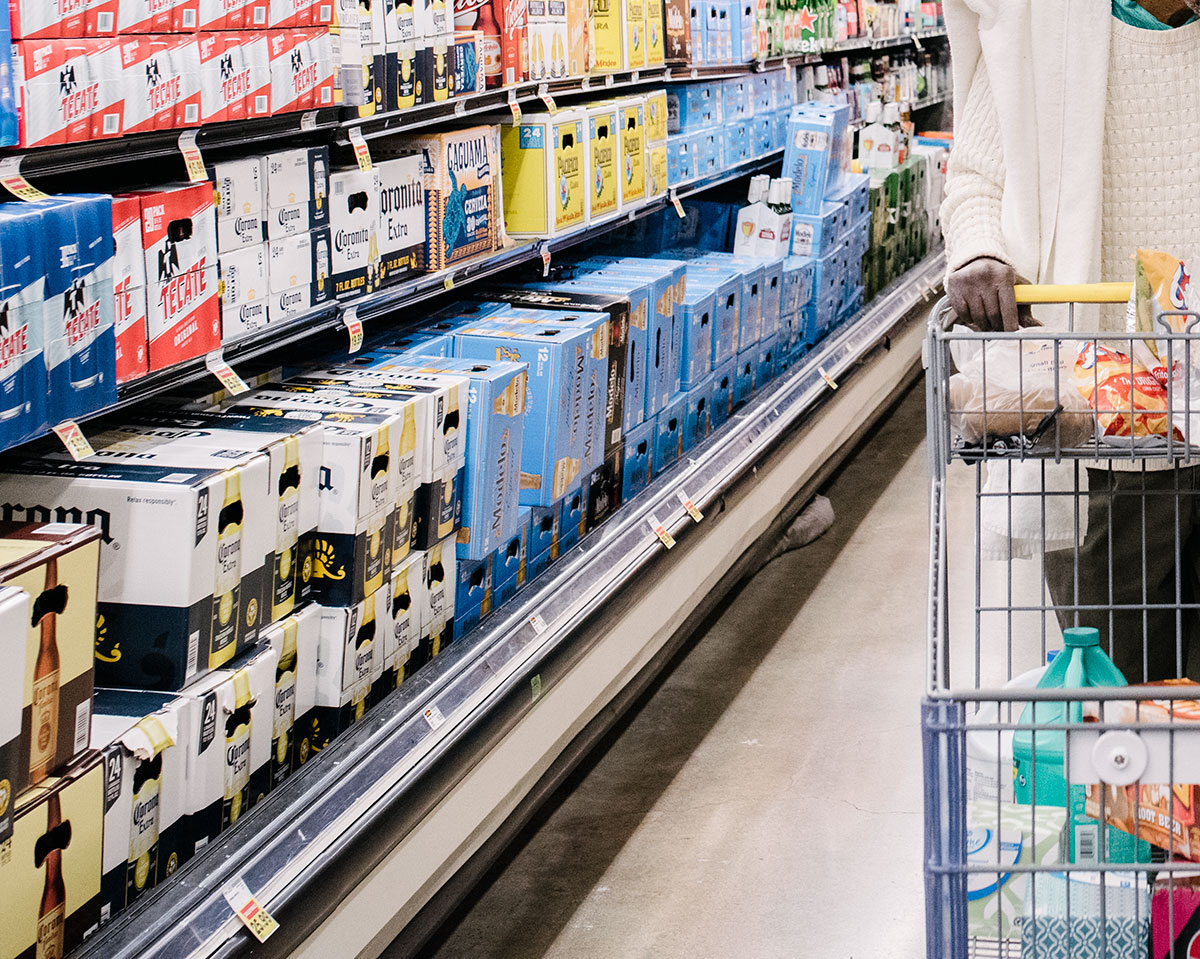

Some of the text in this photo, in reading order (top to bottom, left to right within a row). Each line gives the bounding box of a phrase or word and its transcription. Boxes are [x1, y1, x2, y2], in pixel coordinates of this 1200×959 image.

[221, 68, 252, 102] TECATE
[290, 61, 319, 97] TECATE
[59, 82, 100, 122] TECATE
[148, 75, 182, 111] TECATE
[523, 128, 541, 138] 24
[447, 136, 489, 173] CAGUAMA
[380, 178, 424, 220] oronita
[235, 215, 259, 240] Corona
[278, 204, 301, 229] Corona
[388, 216, 408, 242] Extra
[335, 227, 370, 254] Coronita
[347, 248, 360, 261] Extra
[158, 256, 208, 322] TECATE
[240, 302, 263, 325] Corona
[279, 291, 302, 313] Corona
[65, 302, 101, 347] TECATE
[173, 320, 199, 348] ORIGINAL
[538, 347, 549, 363] 12
[469, 388, 478, 404] 12
[606, 368, 617, 419] Modelo
[492, 442, 509, 530] Modelo
[127, 496, 175, 507] Relax responsibly
[198, 493, 208, 519] 24
[279, 502, 299, 523] Corona
[0, 502, 114, 544] rona
[218, 541, 241, 565] Corona
[222, 560, 237, 575] Extra
[275, 685, 296, 710] Corona
[279, 700, 294, 717] Extra
[204, 700, 217, 724] 24
[227, 739, 251, 767] Corona
[107, 759, 122, 784] 24
[233, 757, 249, 777] Extra
[133, 792, 159, 827] Corona
[138, 816, 157, 836] Extra
